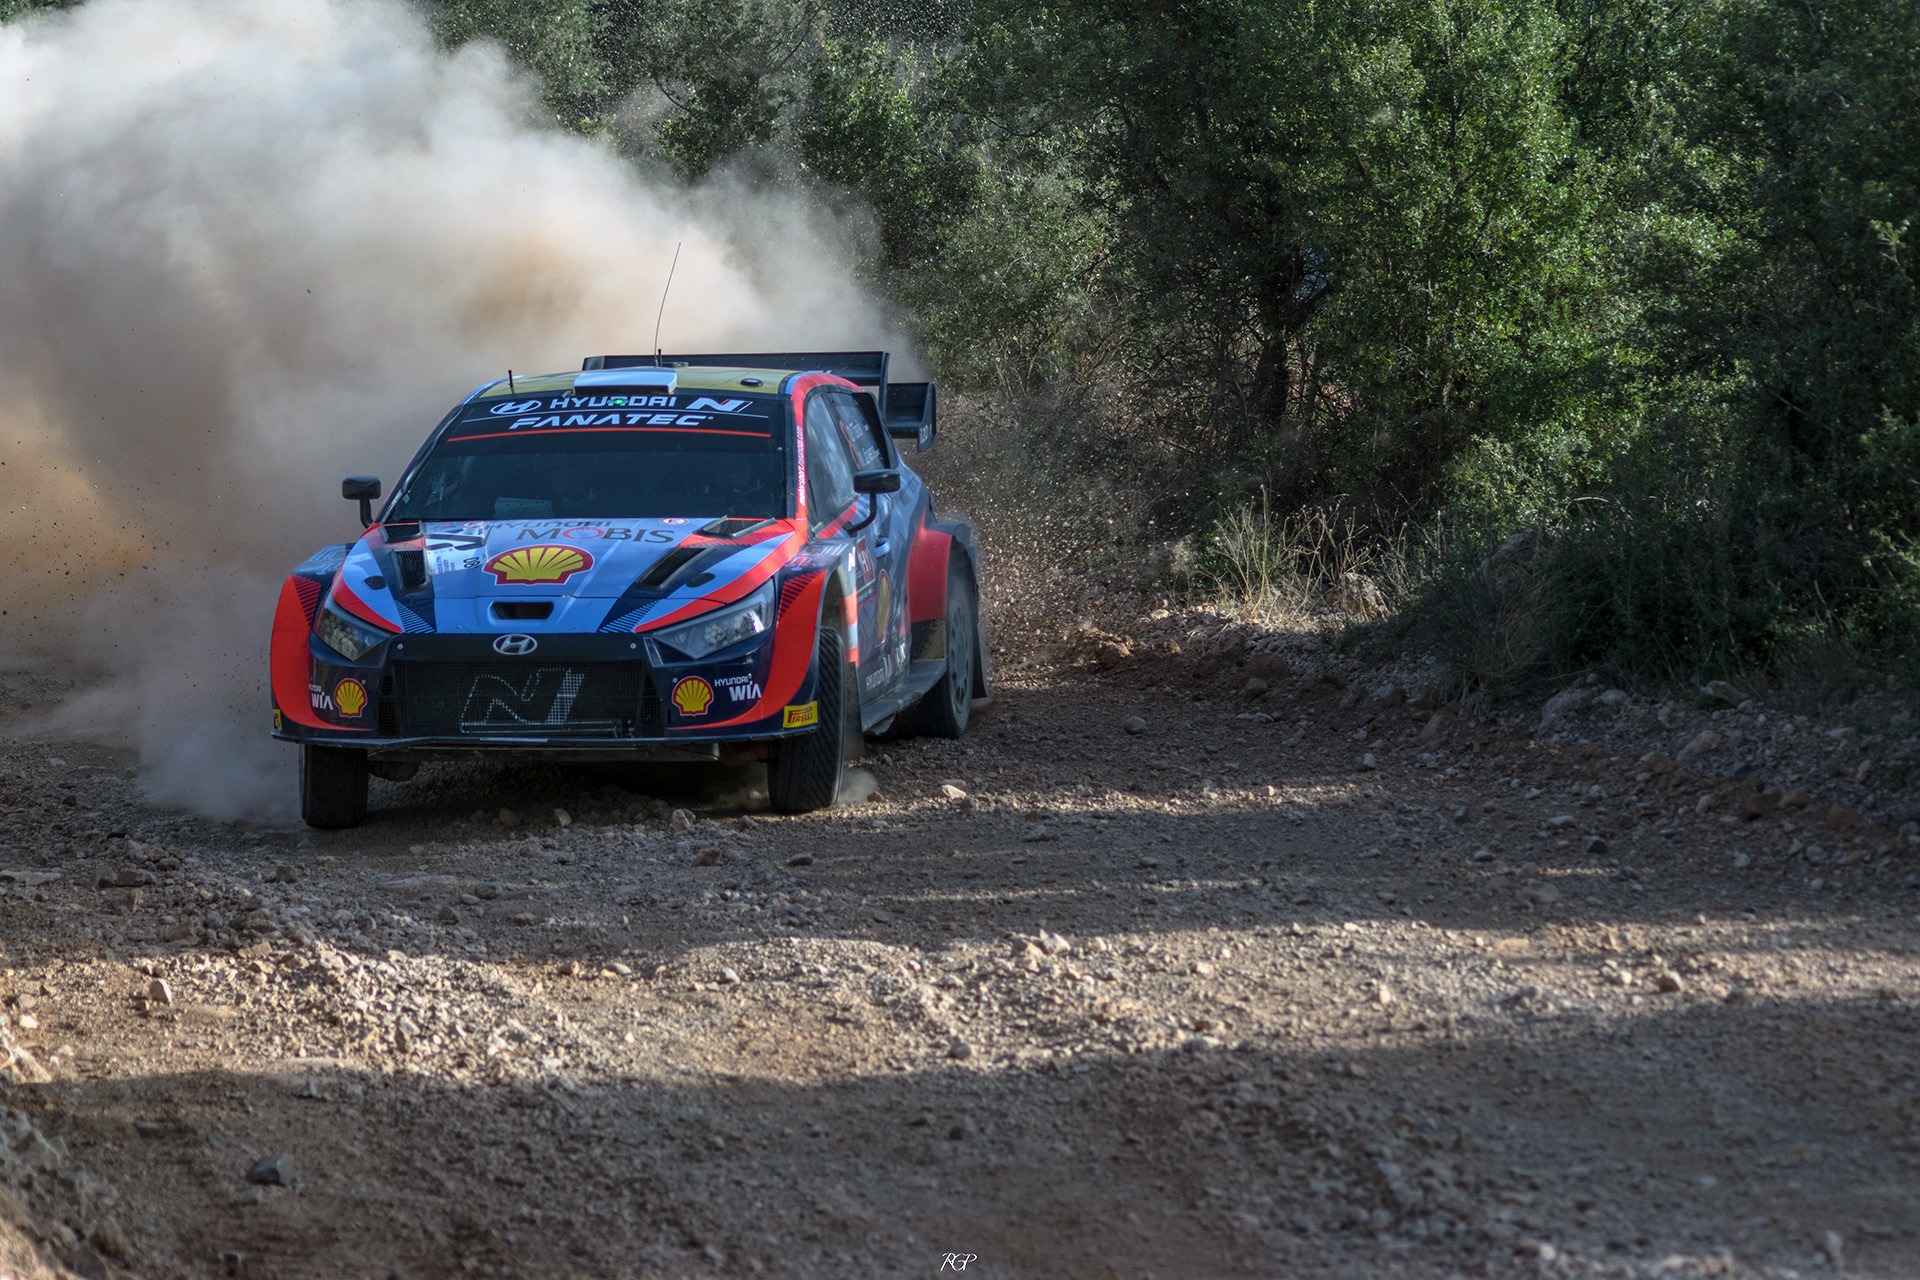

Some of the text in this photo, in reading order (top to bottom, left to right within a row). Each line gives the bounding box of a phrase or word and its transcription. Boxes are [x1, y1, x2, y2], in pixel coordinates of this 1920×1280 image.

[509, 413, 707, 430] FANATEC
[516, 527, 675, 544] MOBIS
[714, 676, 749, 687] HYUNDAI
[787, 706, 813, 724] PIRELLI
